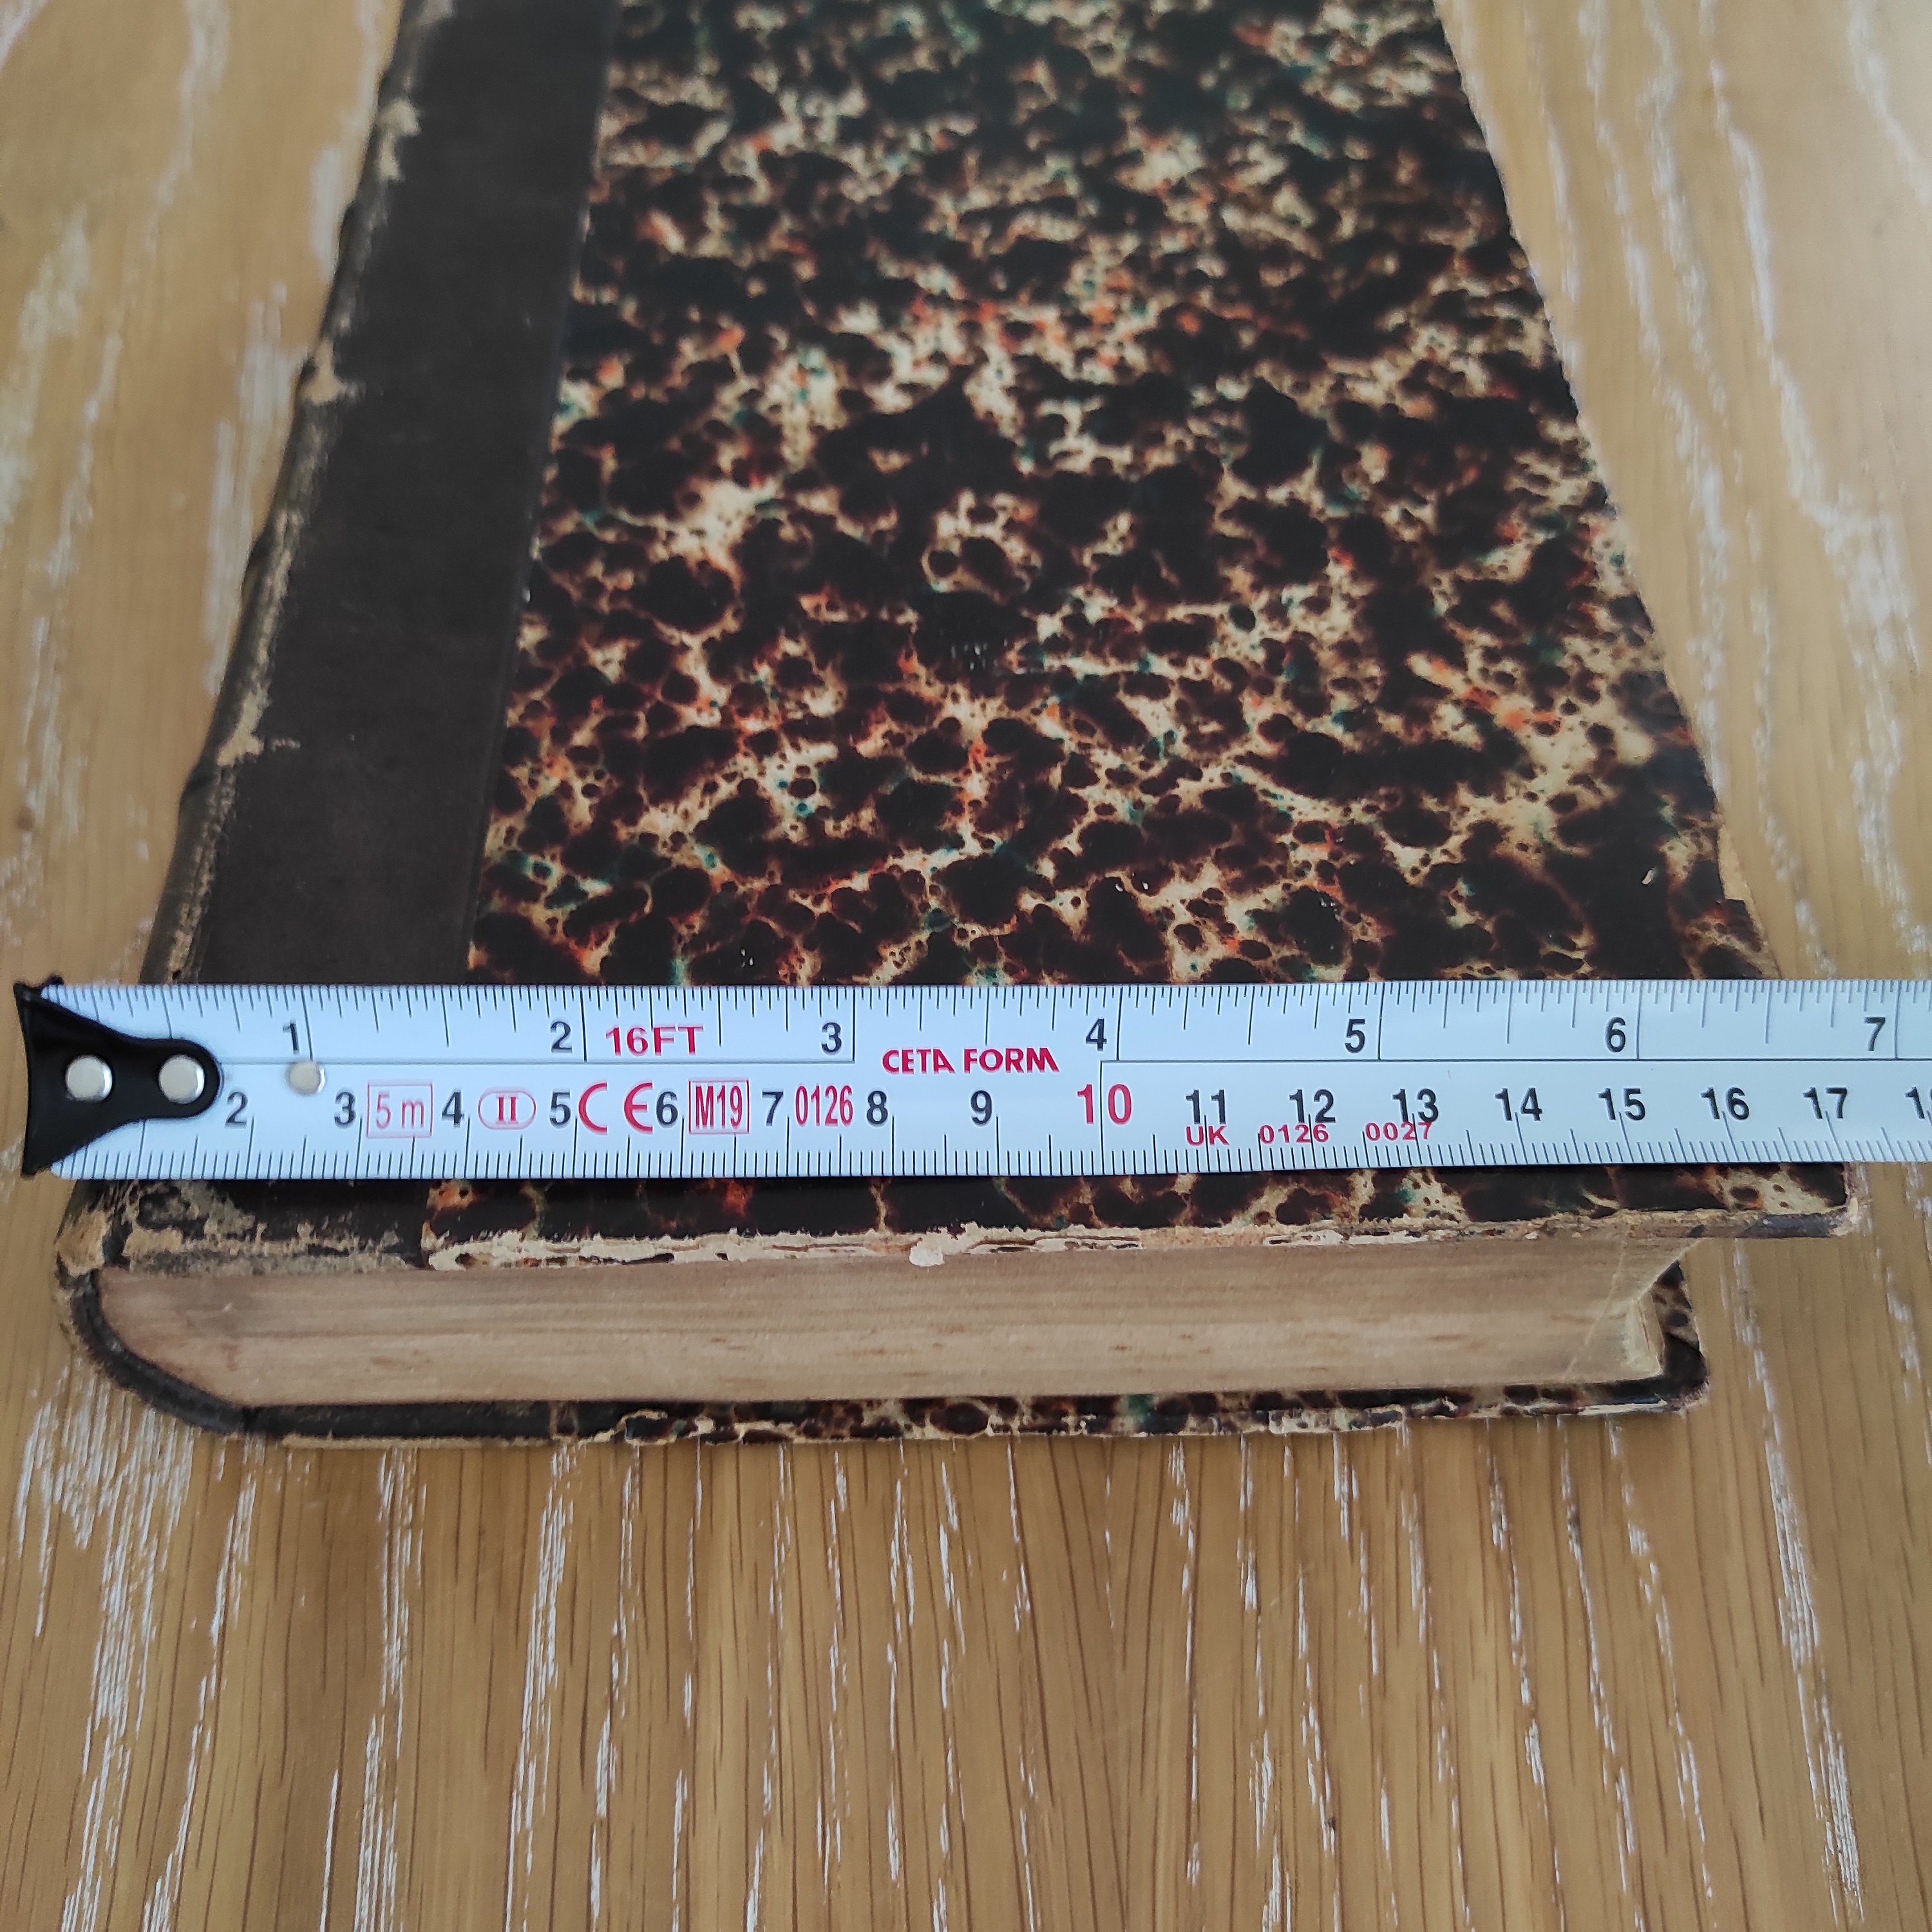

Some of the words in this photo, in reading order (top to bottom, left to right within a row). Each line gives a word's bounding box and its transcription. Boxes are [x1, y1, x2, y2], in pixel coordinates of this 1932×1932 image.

[283, 1021, 300, 1054] 1
[550, 1020, 574, 1054] 2
[605, 1025, 705, 1056] 16FT
[820, 1021, 843, 1056] 3
[1085, 1018, 1107, 1052] 4
[1344, 1018, 1367, 1054] 5
[1604, 1016, 1627, 1054] 6
[1864, 1016, 1887, 1052] 7
[882, 1048, 956, 1074] CETA
[963, 1047, 1060, 1074] FORM
[225, 1091, 249, 1126] 2
[333, 1091, 357, 1126] 3
[441, 1091, 465, 1127] 4
[549, 1092, 572, 1127] 5
[655, 1091, 679, 1127] 6
[694, 1084, 744, 1128] M19
[761, 1091, 784, 1127] 7
[795, 1084, 854, 1128] 0126
[866, 1090, 889, 1127] 8
[970, 1090, 993, 1126] 9
[1076, 1083, 1133, 1126] 10
[1185, 1089, 1226, 1125] 11
[1289, 1088, 1336, 1124] 12
[1392, 1088, 1439, 1124] 13
[1494, 1087, 1543, 1122] 14
[1597, 1087, 1647, 1122] 15
[1700, 1087, 1750, 1121] 16
[1803, 1087, 1849, 1120] 17
[1904, 1086, 1932, 1120] 1
[1186, 1124, 1231, 1147] UK
[1259, 1122, 1330, 1144] 0126
[1365, 1122, 1434, 1142] 0027
